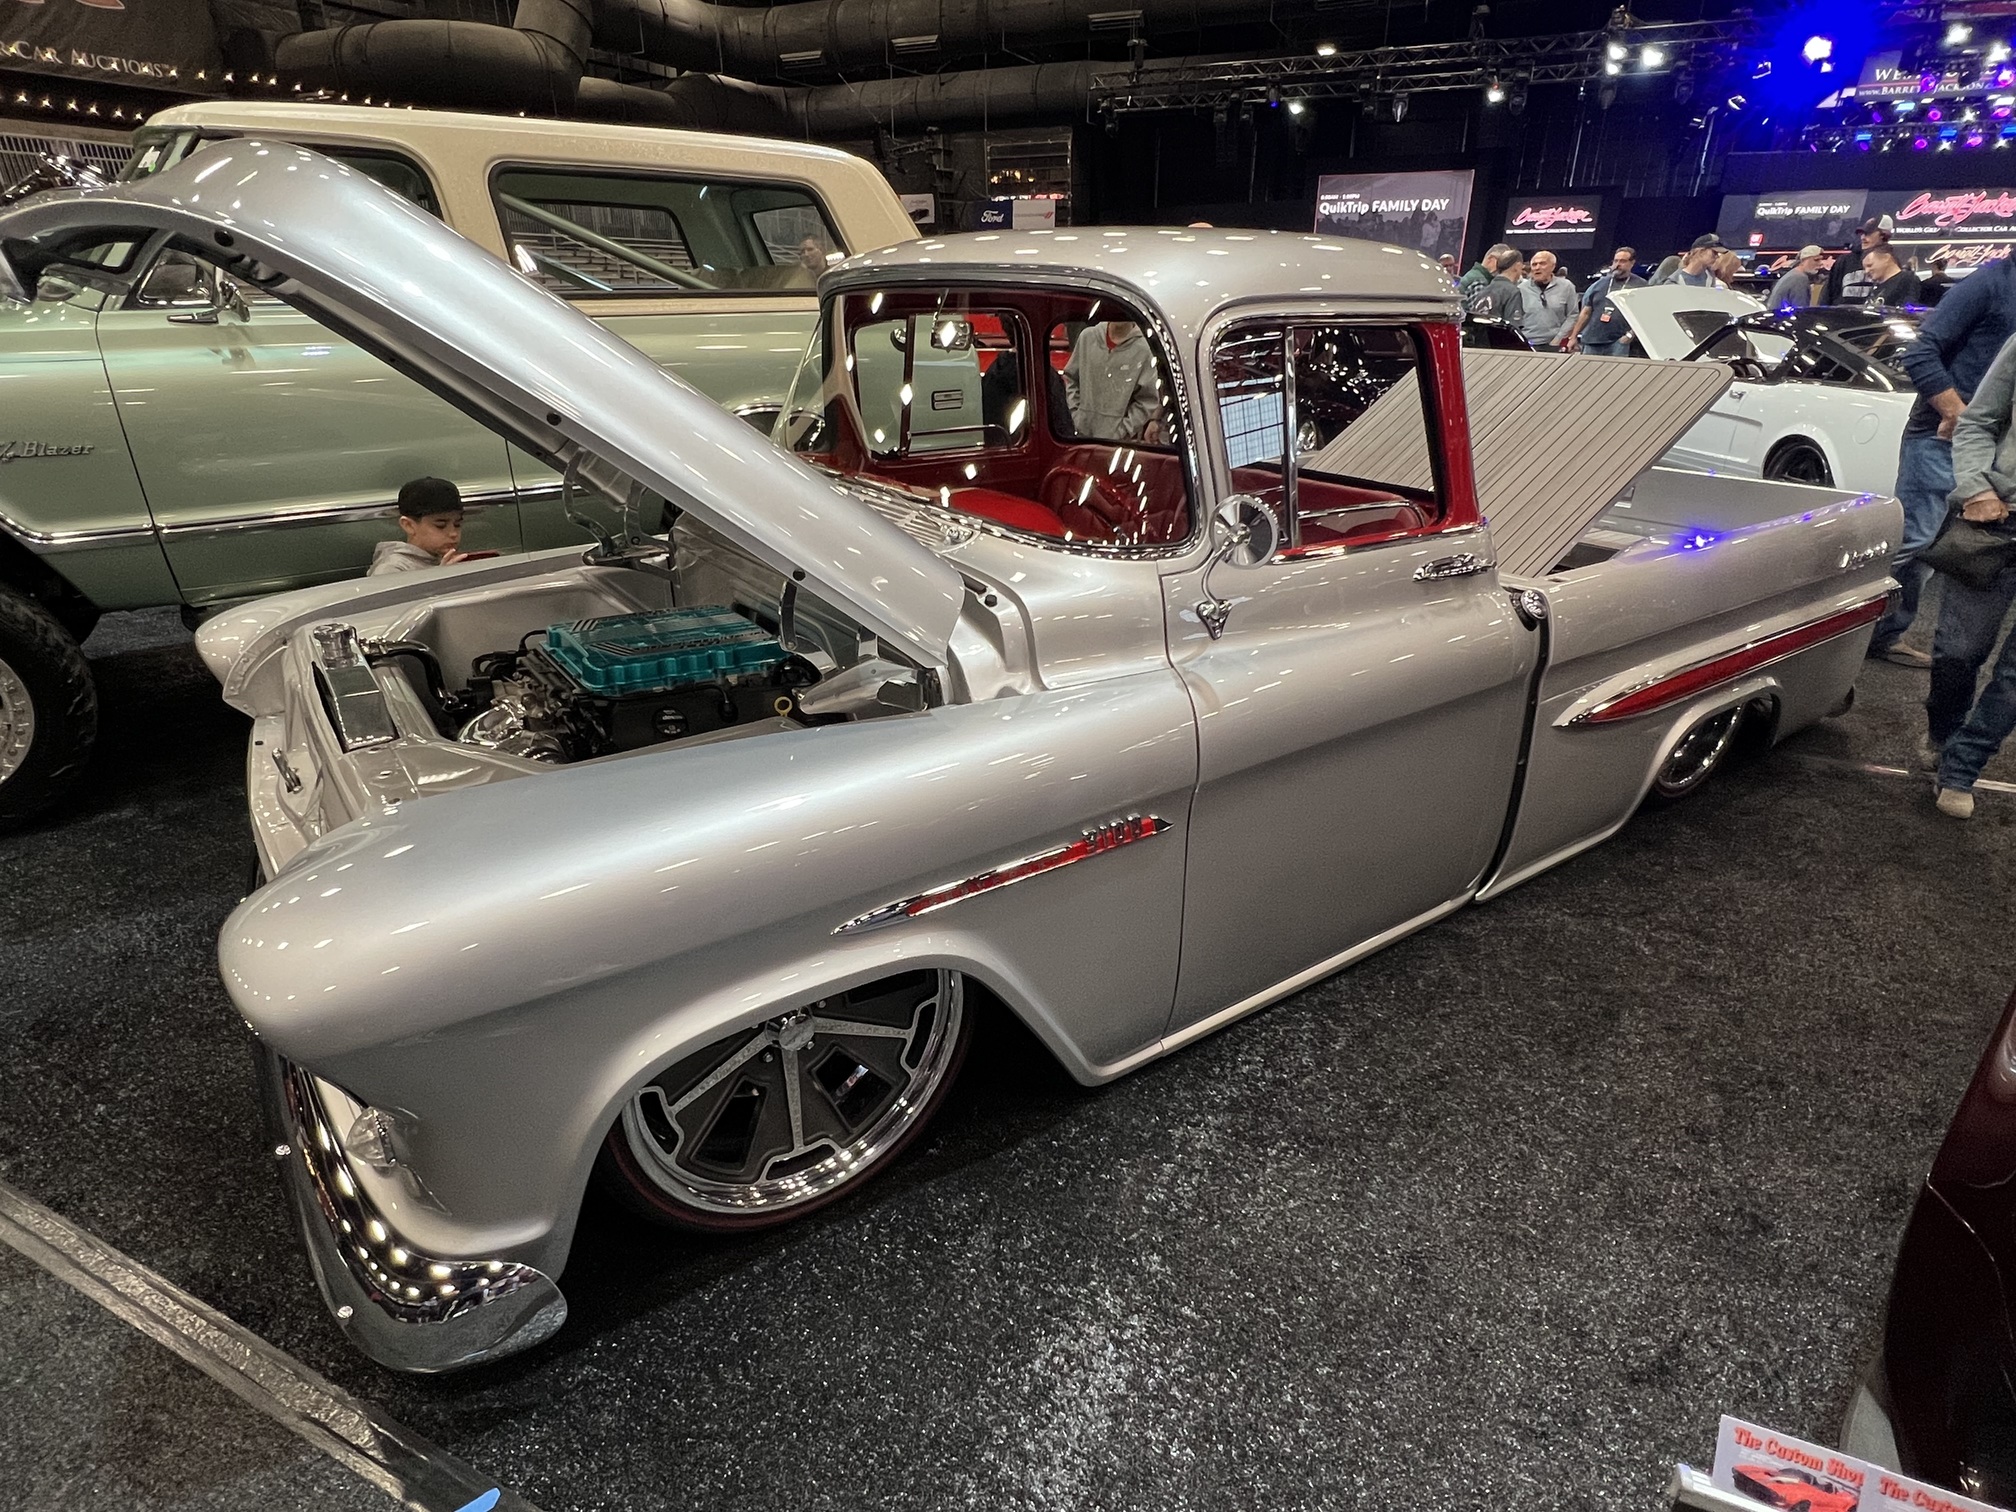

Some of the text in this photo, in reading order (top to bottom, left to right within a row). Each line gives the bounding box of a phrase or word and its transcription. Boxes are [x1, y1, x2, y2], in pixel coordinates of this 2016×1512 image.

[16, 41, 62, 64] CAR
[1319, 199, 1449, 215] QuikTrip FAMILY DAY
[1756, 205, 1850, 216] QuikTrip FAMILY DAY
[981, 210, 1004, 223] Ford
[20, 440, 94, 458] Blazer
[1734, 1426, 1763, 1451] The
[1765, 1438, 1824, 1472] Custom
[1880, 1475, 1910, 1502] The
